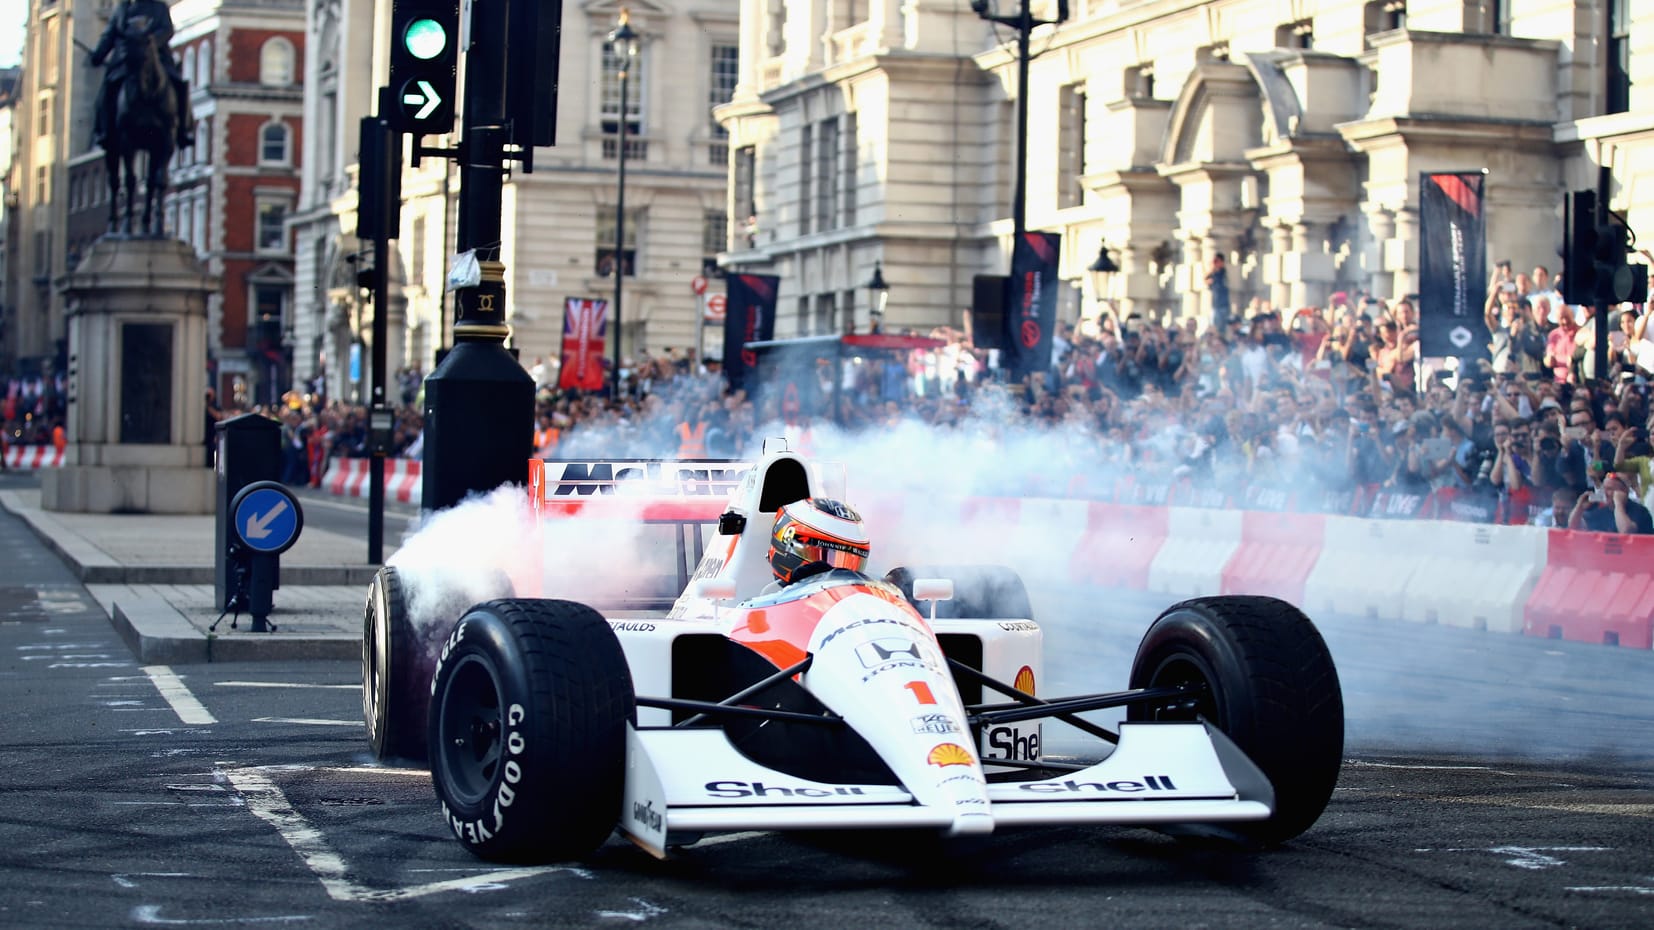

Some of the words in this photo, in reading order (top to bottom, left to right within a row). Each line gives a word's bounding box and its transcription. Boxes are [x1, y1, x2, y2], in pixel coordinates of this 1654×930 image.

[609, 621, 656, 632] TAULDS
[430, 622, 467, 696] EAGLE
[903, 680, 938, 705] 1
[704, 781, 865, 798] Shell
